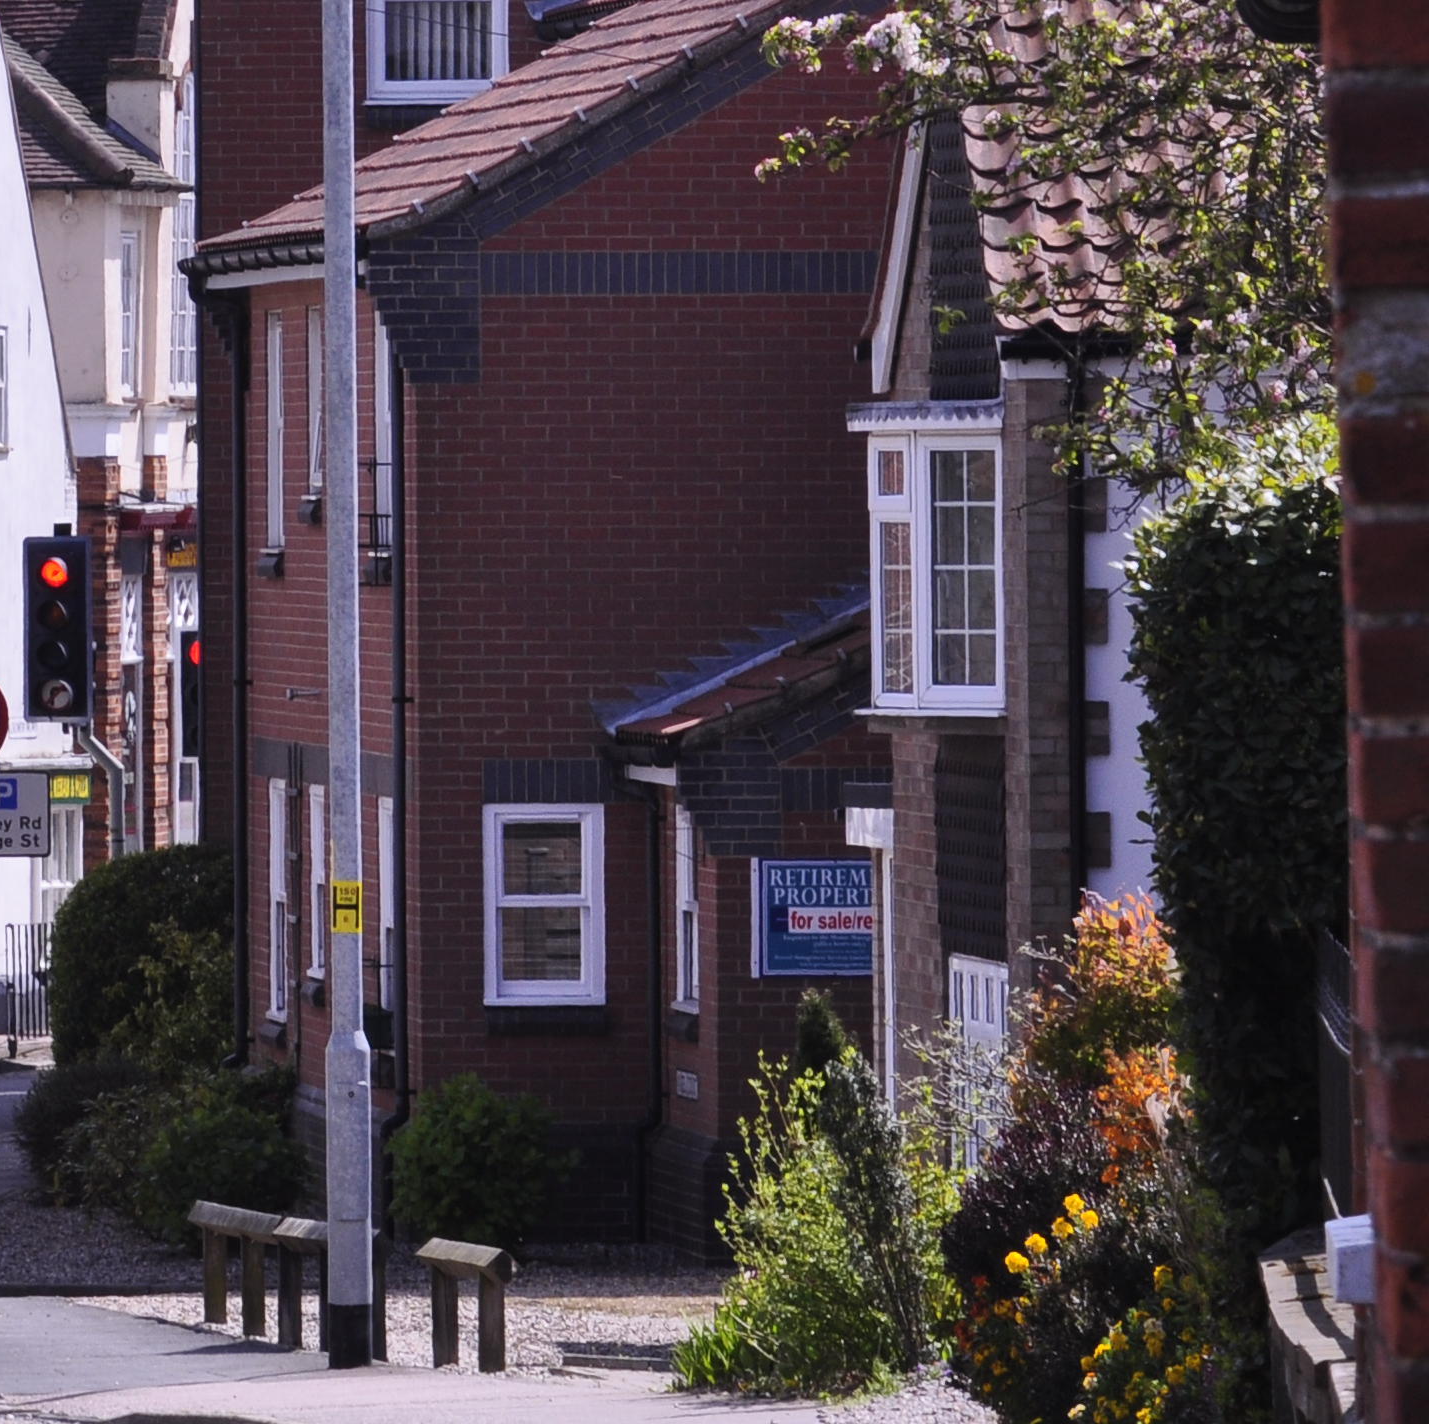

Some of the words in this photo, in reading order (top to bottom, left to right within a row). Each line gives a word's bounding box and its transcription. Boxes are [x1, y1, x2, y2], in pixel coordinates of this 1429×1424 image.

[19, 816, 41, 830] Rd
[20, 834, 40, 848] St
[770, 868, 872, 887] RETIREM
[791, 910, 813, 930] for
